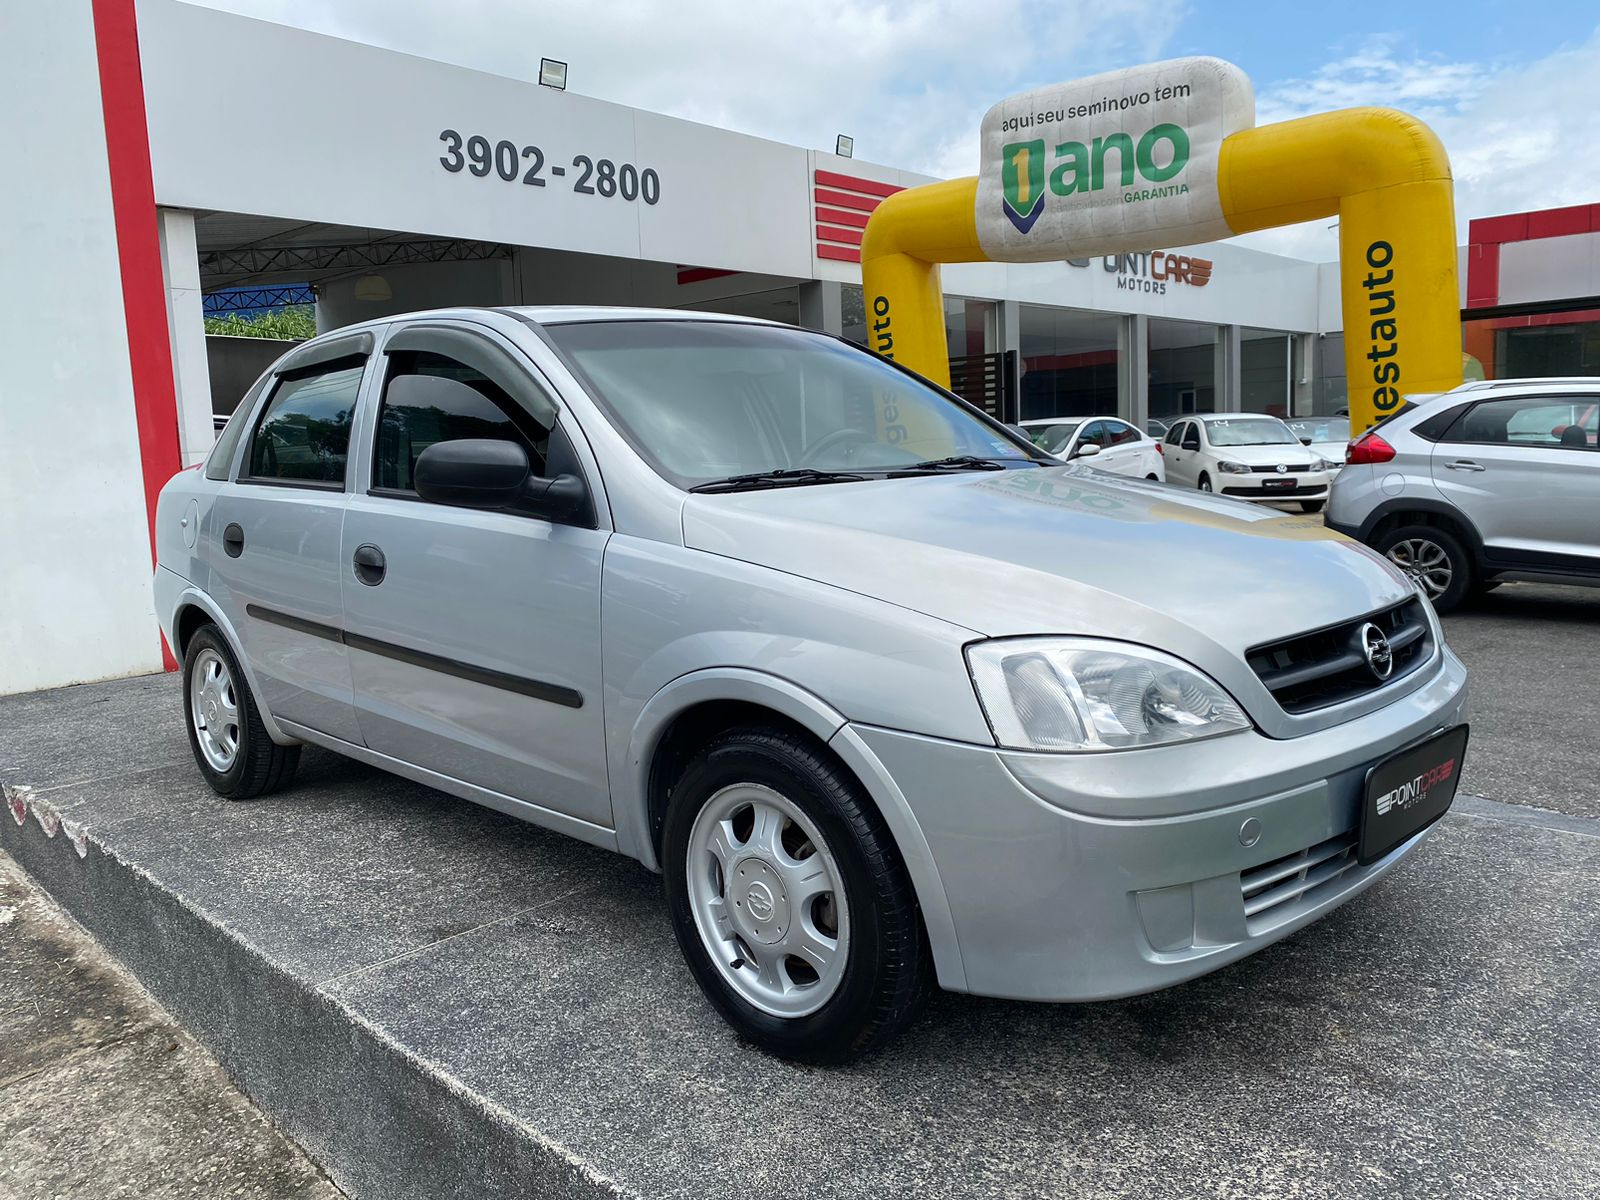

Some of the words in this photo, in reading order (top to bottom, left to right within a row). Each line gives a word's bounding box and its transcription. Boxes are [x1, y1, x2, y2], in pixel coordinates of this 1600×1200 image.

[1002, 112, 1034, 132] aqui
[1037, 107, 1064, 125] seu
[1068, 91, 1150, 119] seminovo
[1155, 84, 1191, 102] tem
[439, 129, 661, 206] 3902-2800
[1012, 148, 1031, 203] 1
[1050, 123, 1190, 196] ano
[1124, 183, 1189, 204] GARANTIA
[1104, 250, 1192, 284] OINTCAR
[1117, 277, 1166, 295] MOTORS
[1363, 240, 1401, 430] estauto
